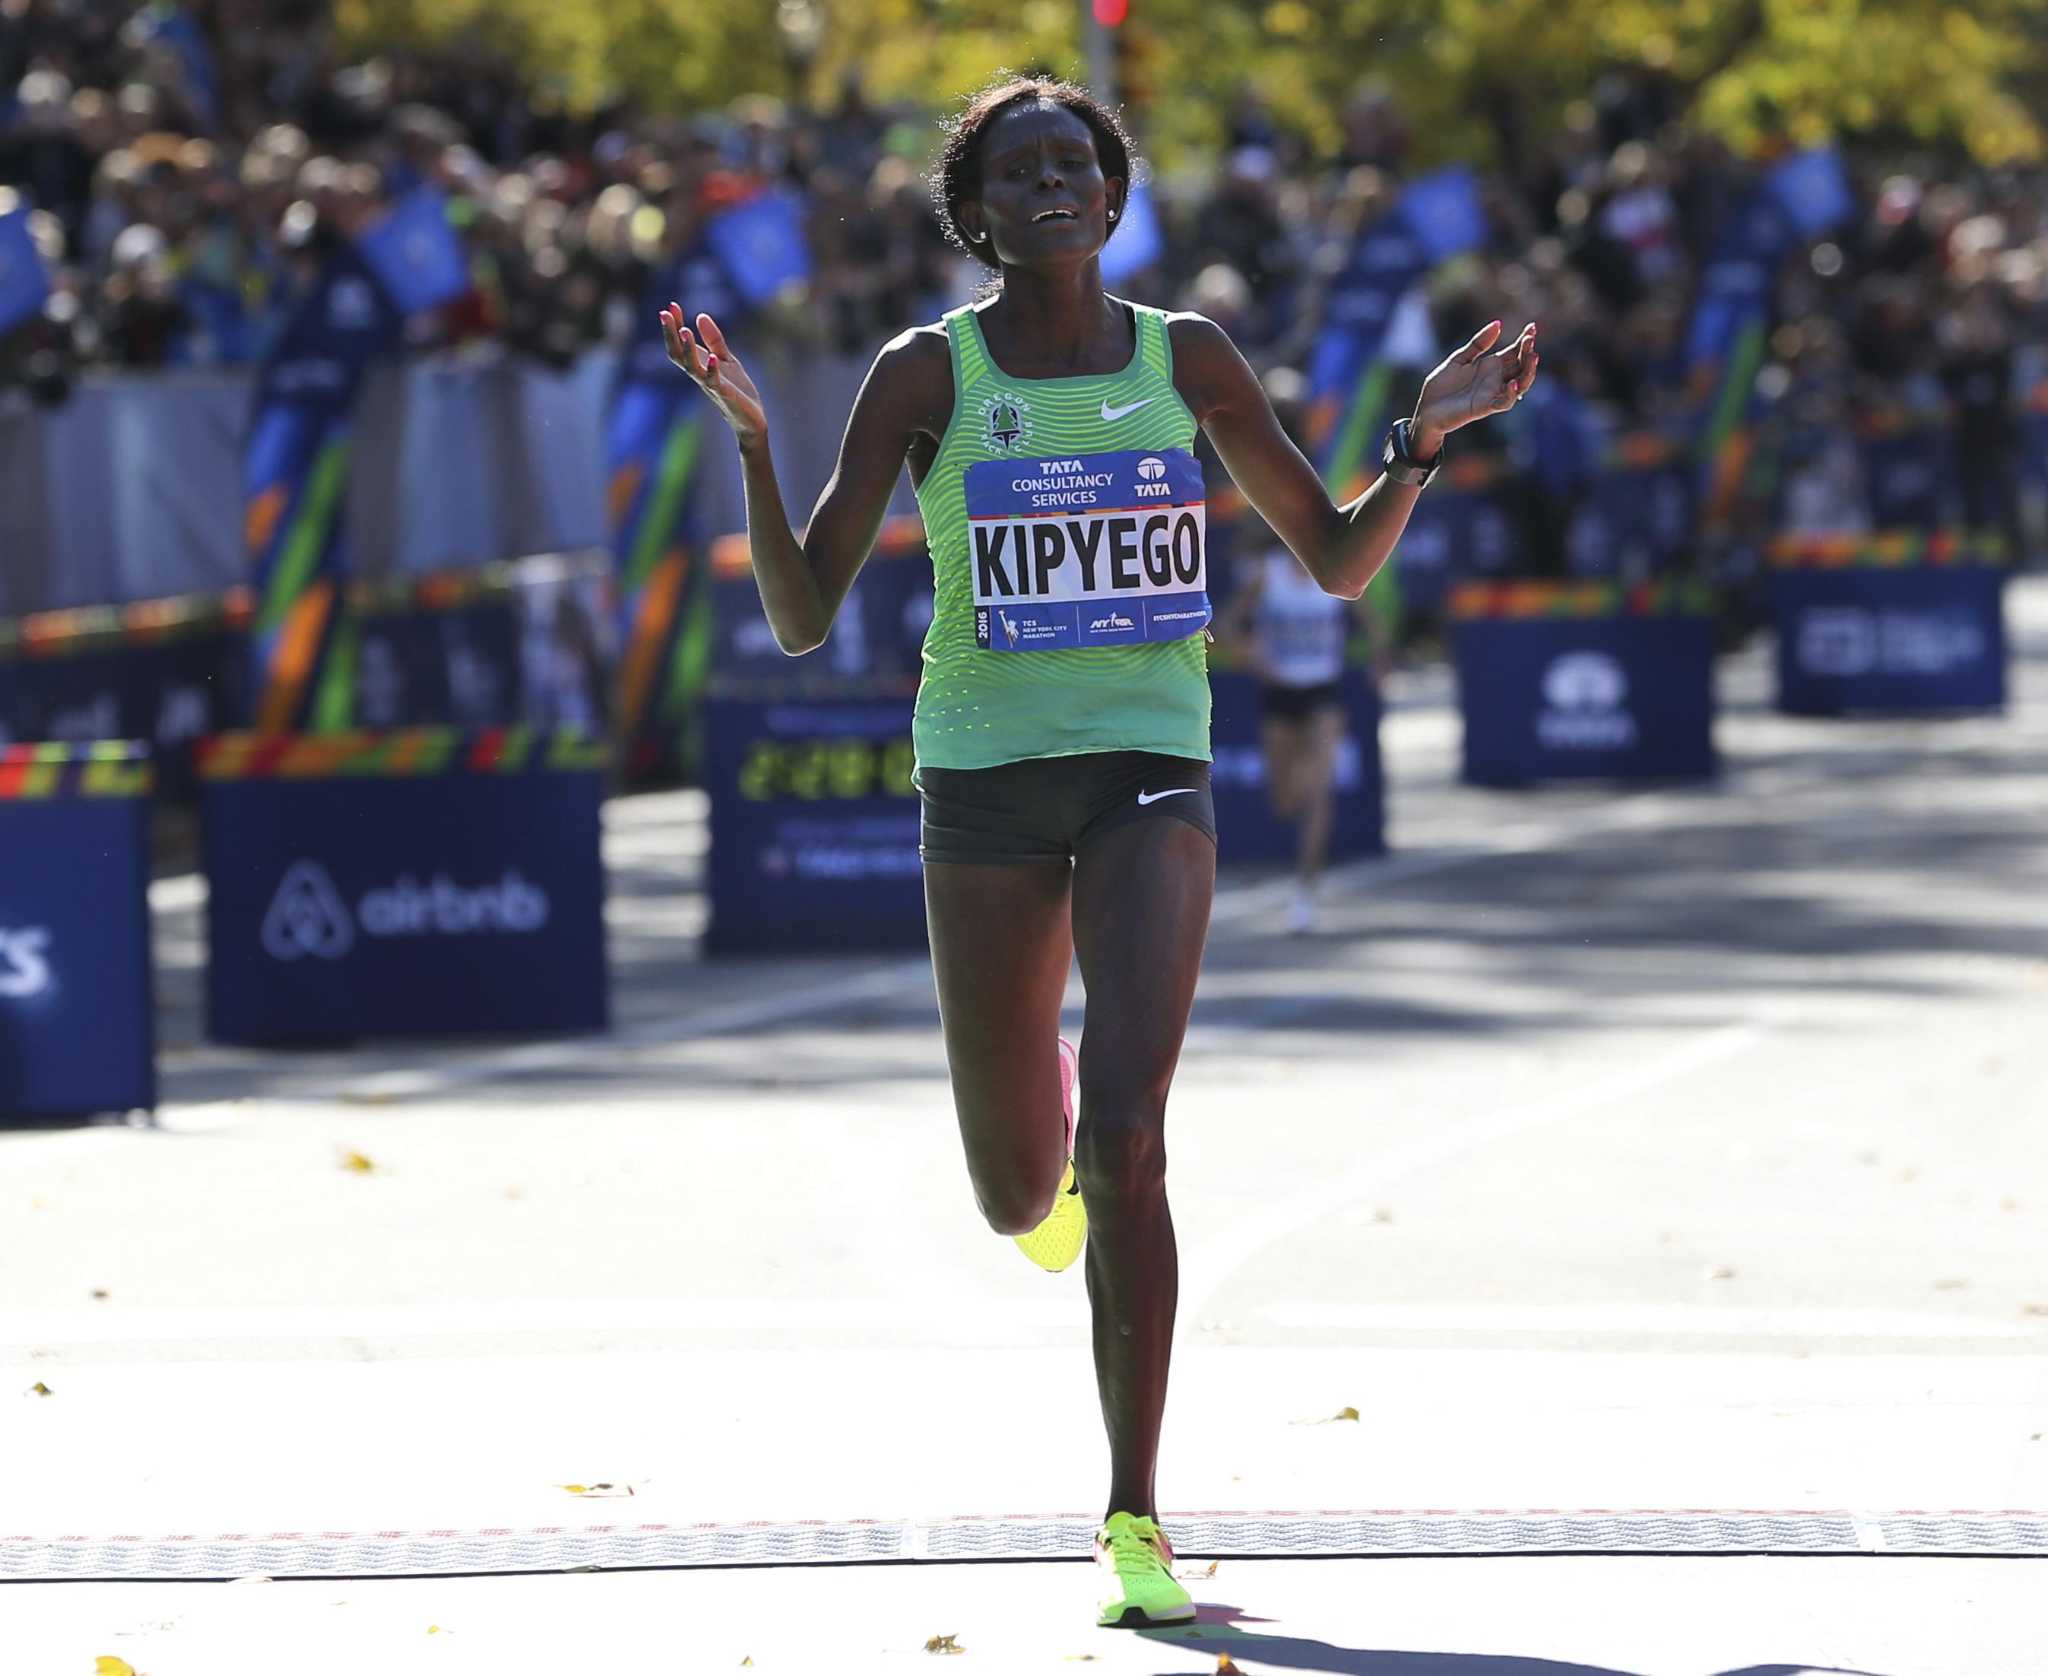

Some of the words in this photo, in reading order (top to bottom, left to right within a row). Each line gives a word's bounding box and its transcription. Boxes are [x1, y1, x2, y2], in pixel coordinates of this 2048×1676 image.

[1040, 460, 1084, 475] TATA
[1012, 473, 1114, 492] CONSULTANCY
[1134, 483, 1171, 497] TATA
[1031, 490, 1097, 507] SERVICES
[974, 512, 1200, 598] KIPYEGO
[978, 611, 988, 639] 2016
[358, 870, 549, 937] airbnb
